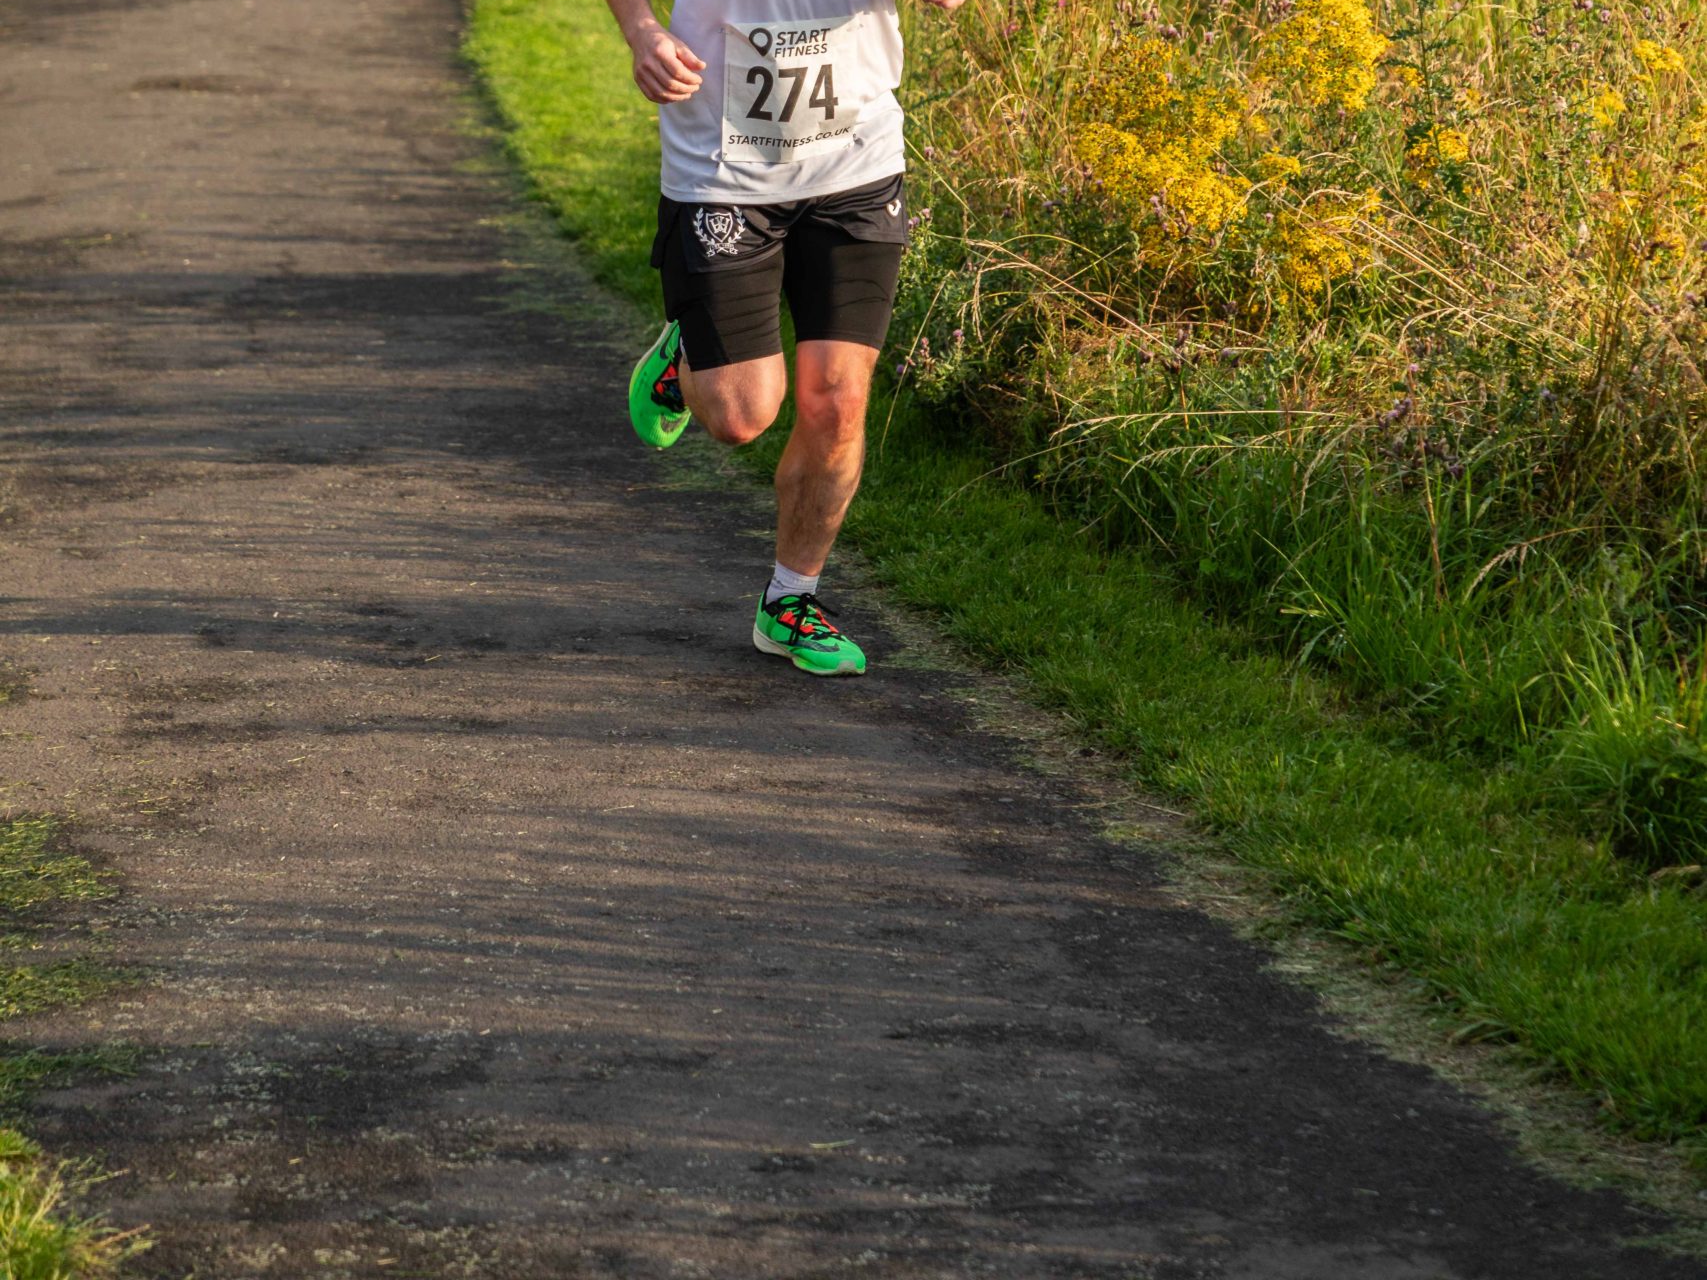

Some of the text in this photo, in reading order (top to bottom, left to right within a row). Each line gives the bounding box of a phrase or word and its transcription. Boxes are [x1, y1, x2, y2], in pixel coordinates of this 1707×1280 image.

[776, 28, 831, 46] START
[774, 43, 828, 58] FITNESS
[745, 63, 839, 123] 274
[728, 126, 851, 148] STARTFITNESS.CO.UK
